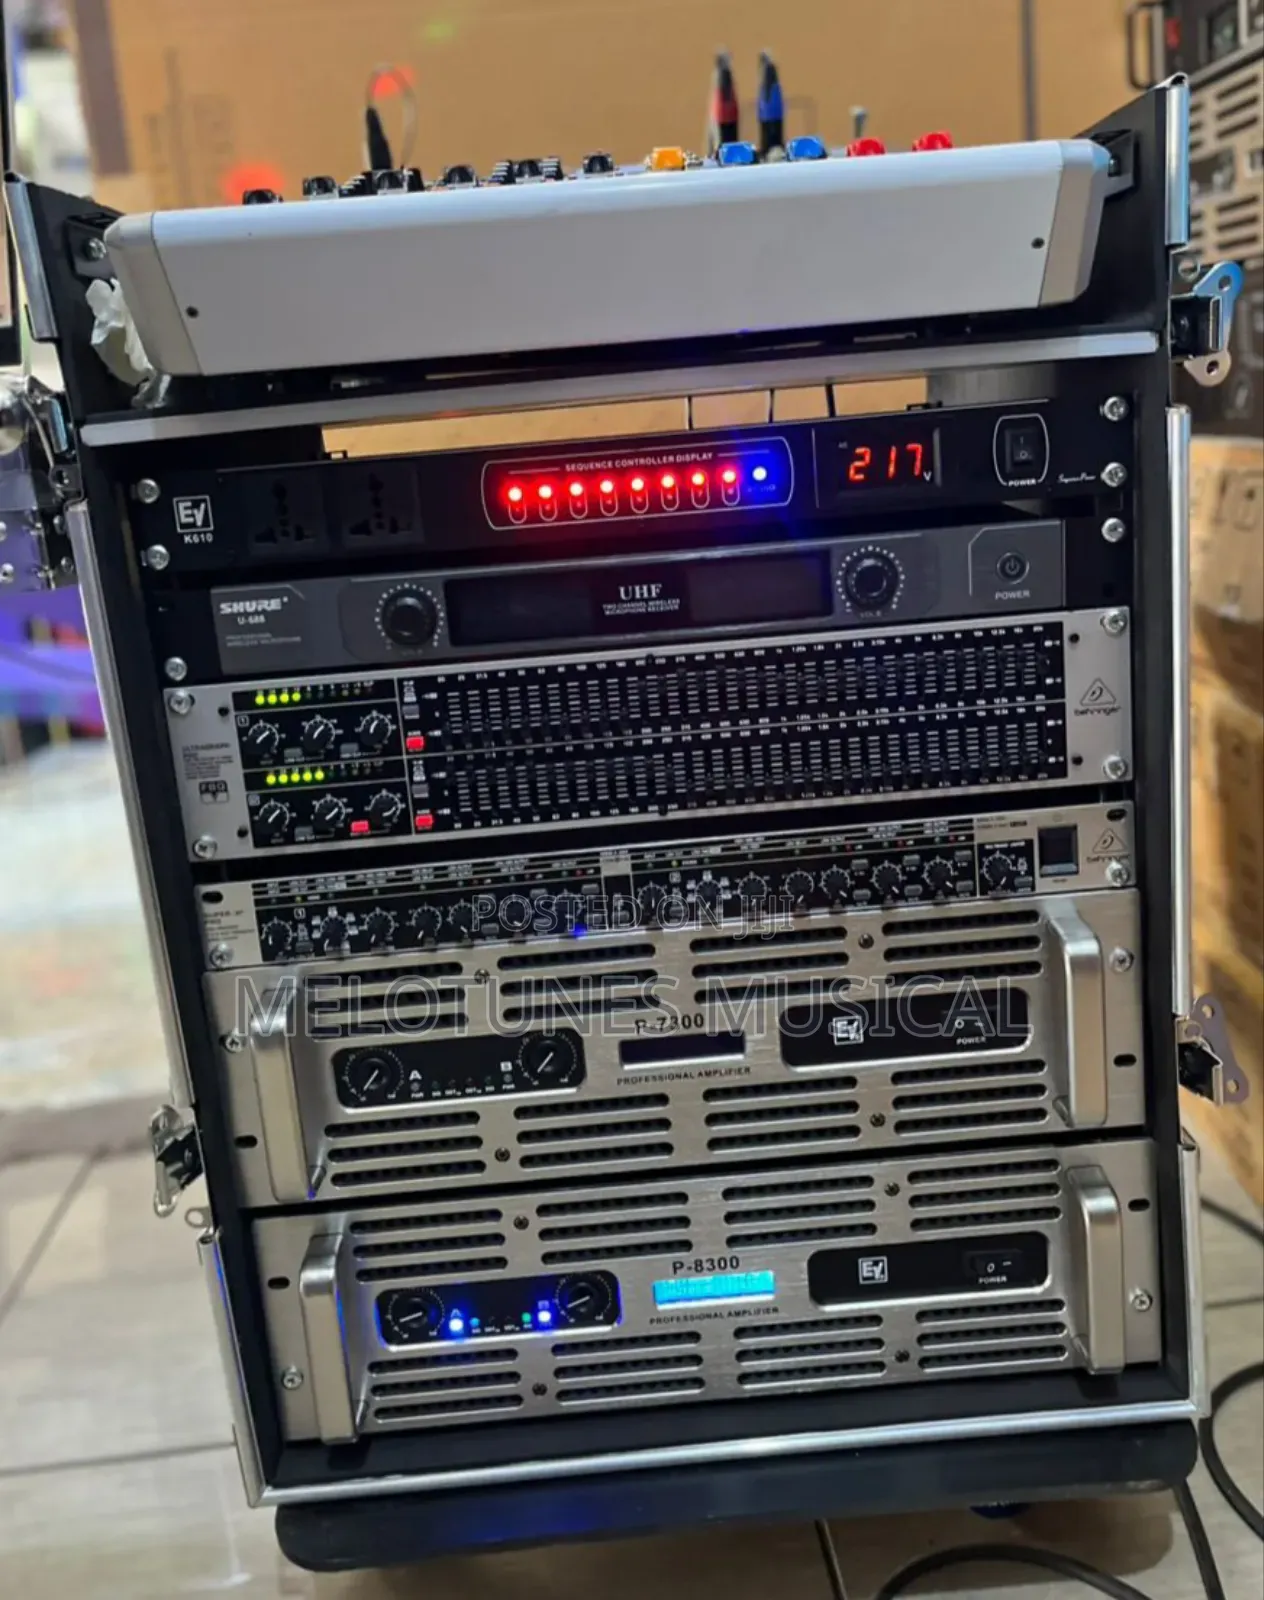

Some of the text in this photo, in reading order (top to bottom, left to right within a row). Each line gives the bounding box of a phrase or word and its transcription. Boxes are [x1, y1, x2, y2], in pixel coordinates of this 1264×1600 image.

[565, 452, 713, 472] SEQUENCE CONTROLLER DISPLAY
[848, 443, 922, 481] 217
[923, 470, 932, 481] V
[1008, 478, 1037, 487] POWER
[183, 532, 214, 544] K610
[619, 583, 663, 601] UHF
[995, 590, 1030, 600] POWER
[219, 598, 282, 615] SHURE
[956, 1036, 987, 1045] POWER
[409, 1069, 422, 1080] A
[616, 1066, 751, 1086] PROFESSIONAL AMPLIFIER
[672, 1255, 740, 1276] P-8300
[978, 1275, 1008, 1285] POWER
[649, 1306, 780, 1325] PROFESSIONAL AMPLIFIER
